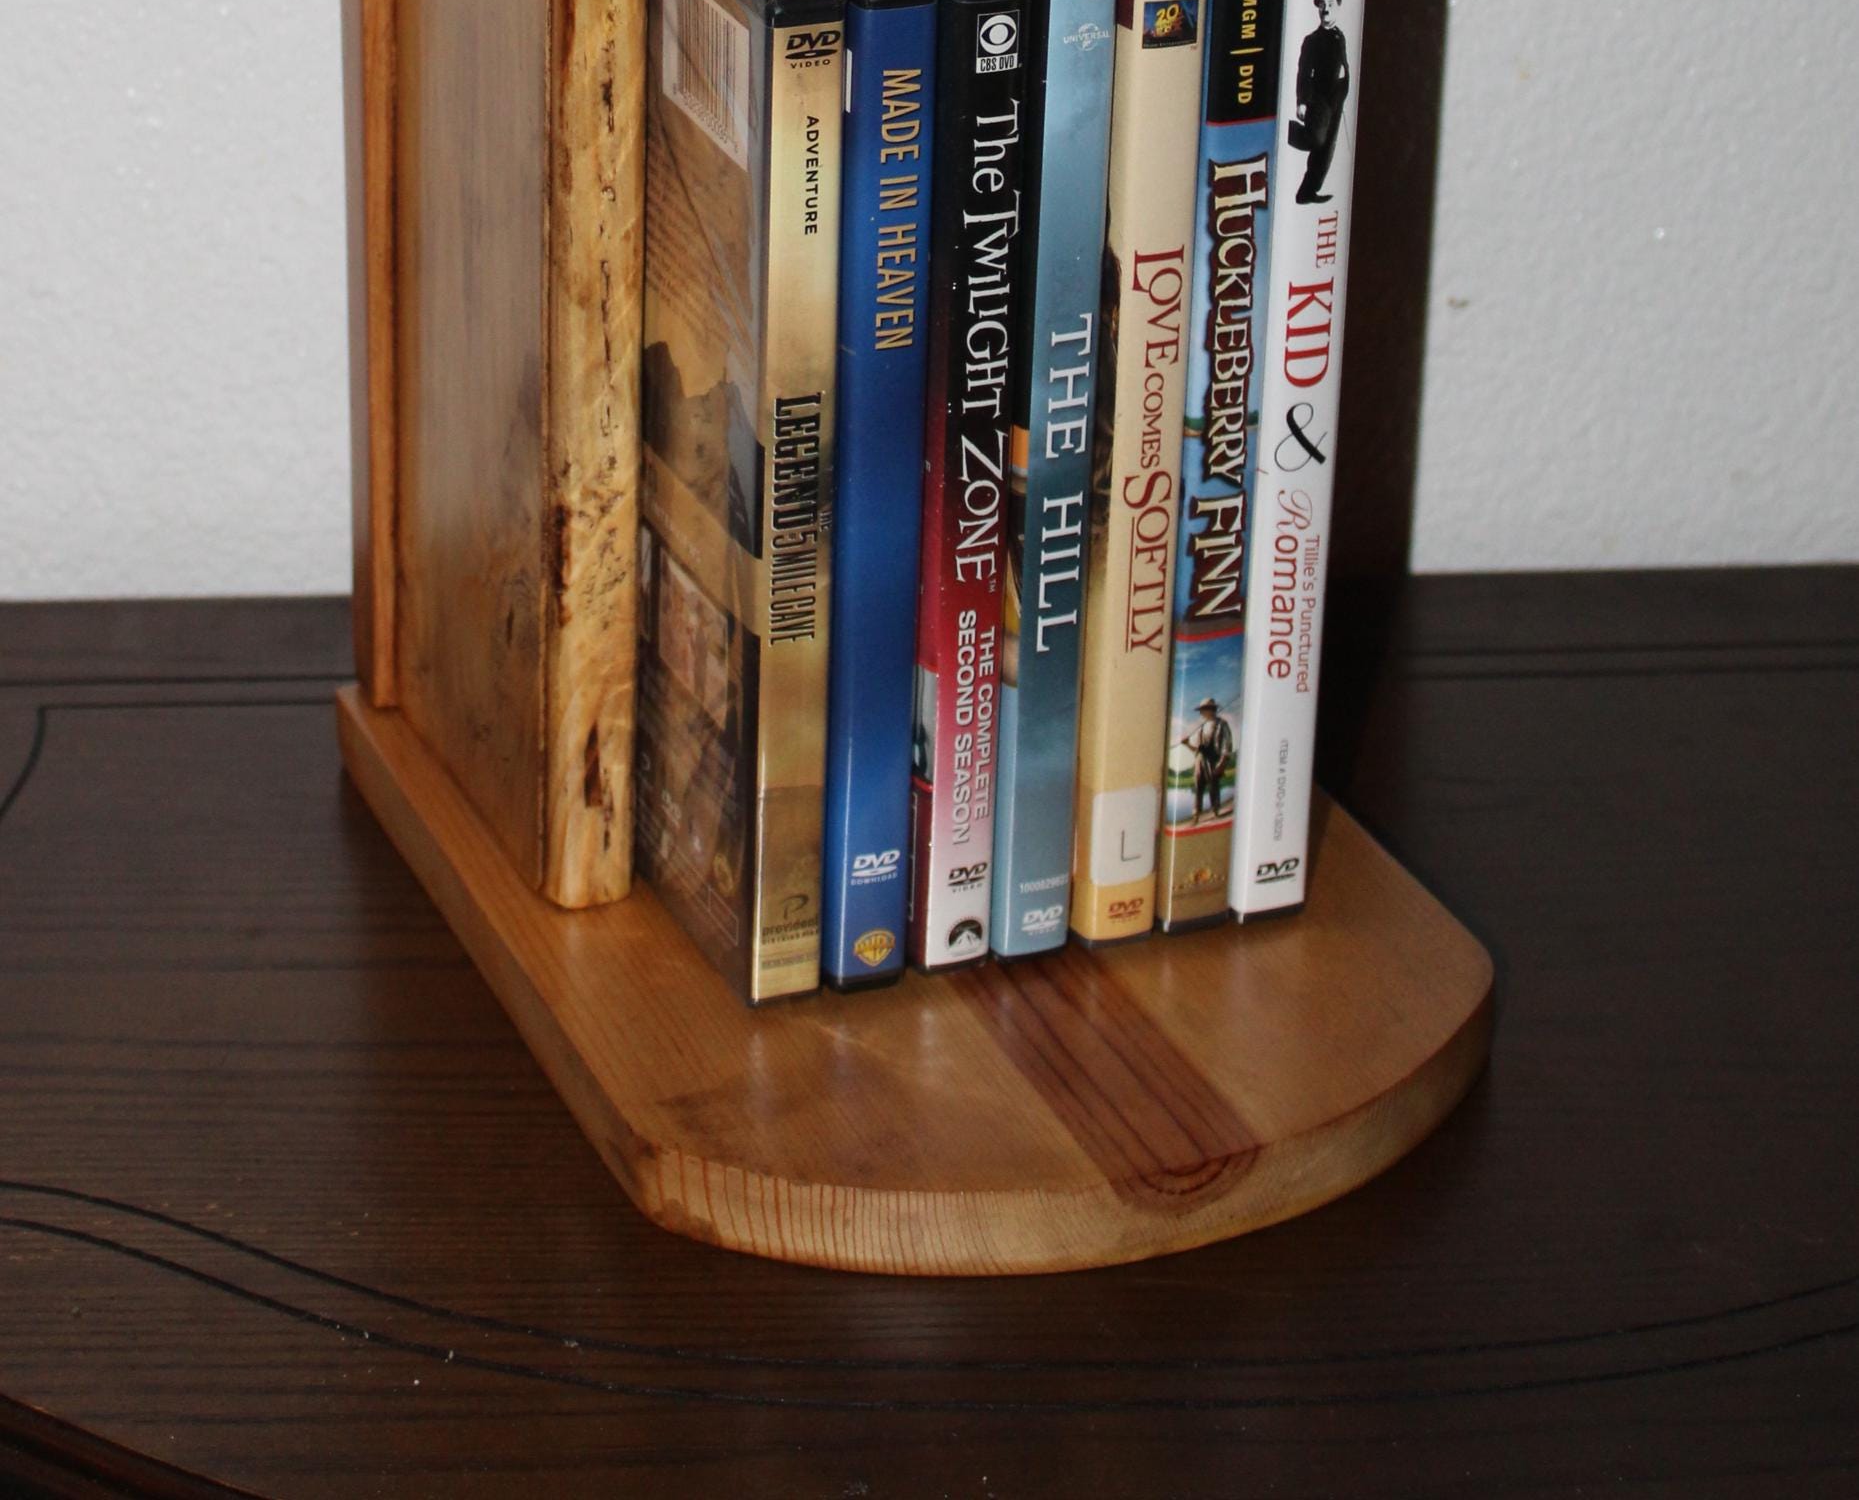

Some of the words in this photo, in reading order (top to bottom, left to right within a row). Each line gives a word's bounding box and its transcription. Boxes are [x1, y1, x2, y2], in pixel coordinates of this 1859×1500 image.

[786, 30, 841, 50] DVD
[790, 59, 831, 69] VIDEO
[980, 58, 997, 72] CBS
[999, 55, 1015, 70] DVD
[1063, 30, 1110, 44] UNIVERSAL
[879, 68, 922, 165] MADE
[1238, 64, 1254, 105] DVD
[804, 115, 820, 236] ADVENTURE
[972, 97, 1020, 194] The
[879, 175, 920, 211] IN
[1315, 210, 1339, 269] THE
[874, 223, 918, 351] HEAVEN
[1132, 244, 1185, 369] LOVE
[1209, 153, 1267, 485] HUCKLEBERRY
[1283, 276, 1334, 388] KID
[1045, 312, 1093, 459] THE
[1140, 373, 1164, 469] COMES
[772, 392, 822, 531] LEGEND
[1273, 402, 1328, 472] &
[772, 529, 818, 549] 5
[955, 429, 1009, 583] ZONE
[771, 550, 817, 596] MILE
[1036, 491, 1085, 652] HILL
[1123, 470, 1173, 654] SOFTLY
[1194, 494, 1244, 618] FINN
[1267, 489, 1313, 679] Romance
[1302, 534, 1320, 590] Tillie's
[768, 596, 816, 647] CAVE
[979, 625, 995, 677] THE
[1296, 596, 1317, 693] Punctured
[956, 609, 977, 726] SECOND
[952, 733, 973, 846] SEASON
[975, 683, 993, 820] COMPLETE
[853, 850, 900, 870] DVD
[948, 862, 988, 880] DVD
[1121, 830, 1141, 861] L
[1257, 857, 1300, 877] DVD
[1023, 904, 1064, 923] DVD
[1108, 897, 1144, 913] DVD
